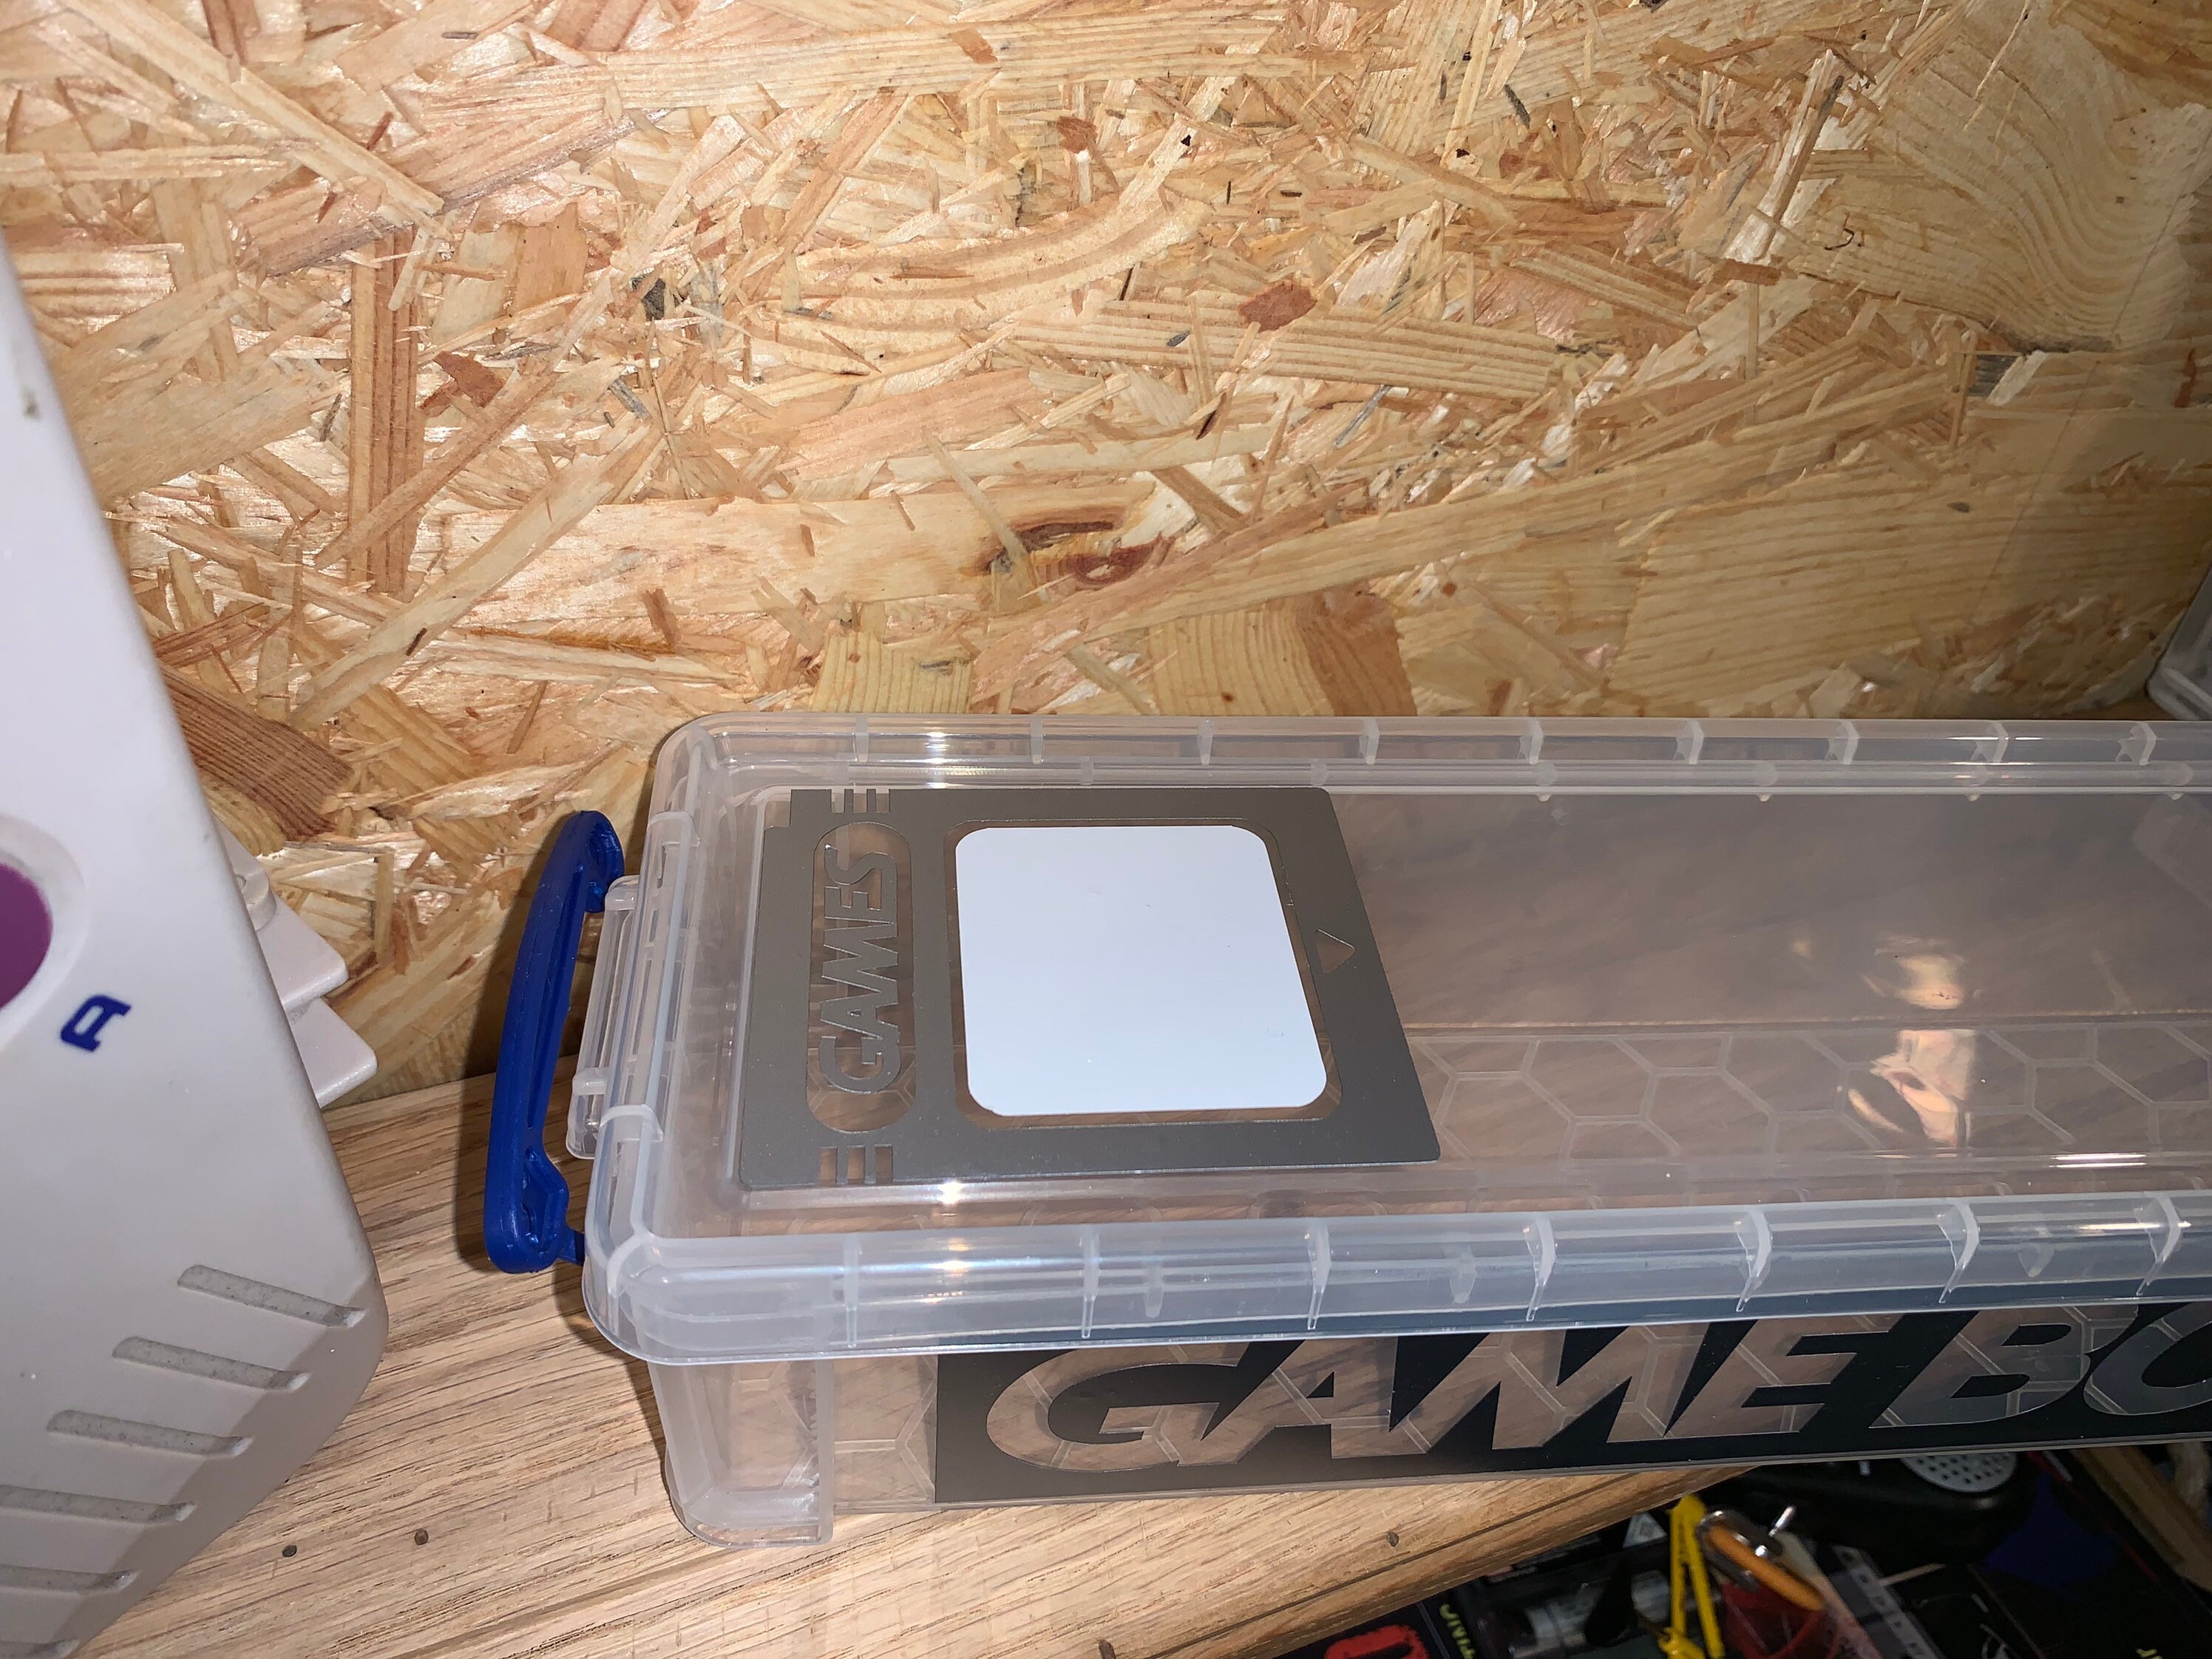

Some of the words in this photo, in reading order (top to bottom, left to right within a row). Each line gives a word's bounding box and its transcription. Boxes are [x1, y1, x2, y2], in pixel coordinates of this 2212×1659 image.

[60, 994, 132, 1053] A
[818, 844, 901, 1094] GAMES
[986, 1311, 1903, 1473] GAME
